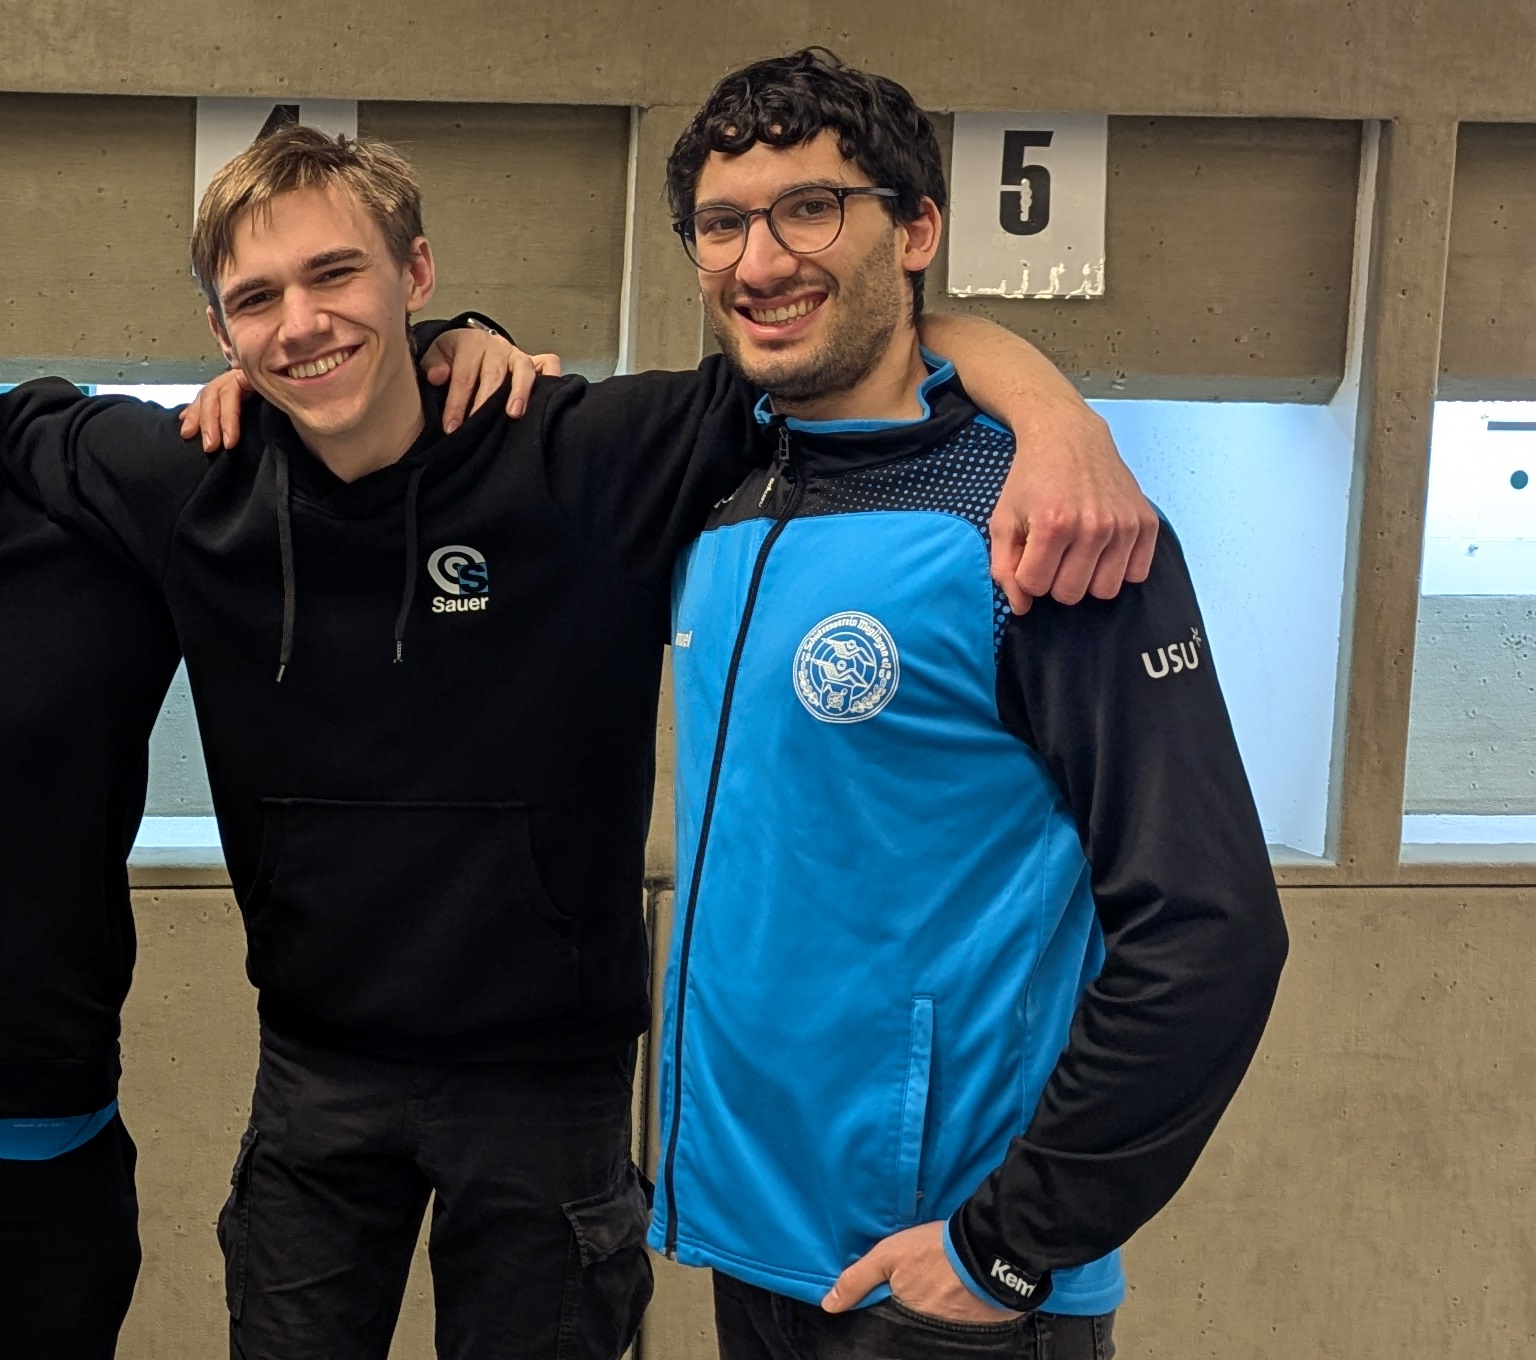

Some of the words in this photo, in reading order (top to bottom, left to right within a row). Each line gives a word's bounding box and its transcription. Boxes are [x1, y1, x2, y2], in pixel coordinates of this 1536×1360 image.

[999, 129, 1055, 236] 5
[431, 596, 489, 613] Sauer
[990, 1258, 1037, 1298] Kem
